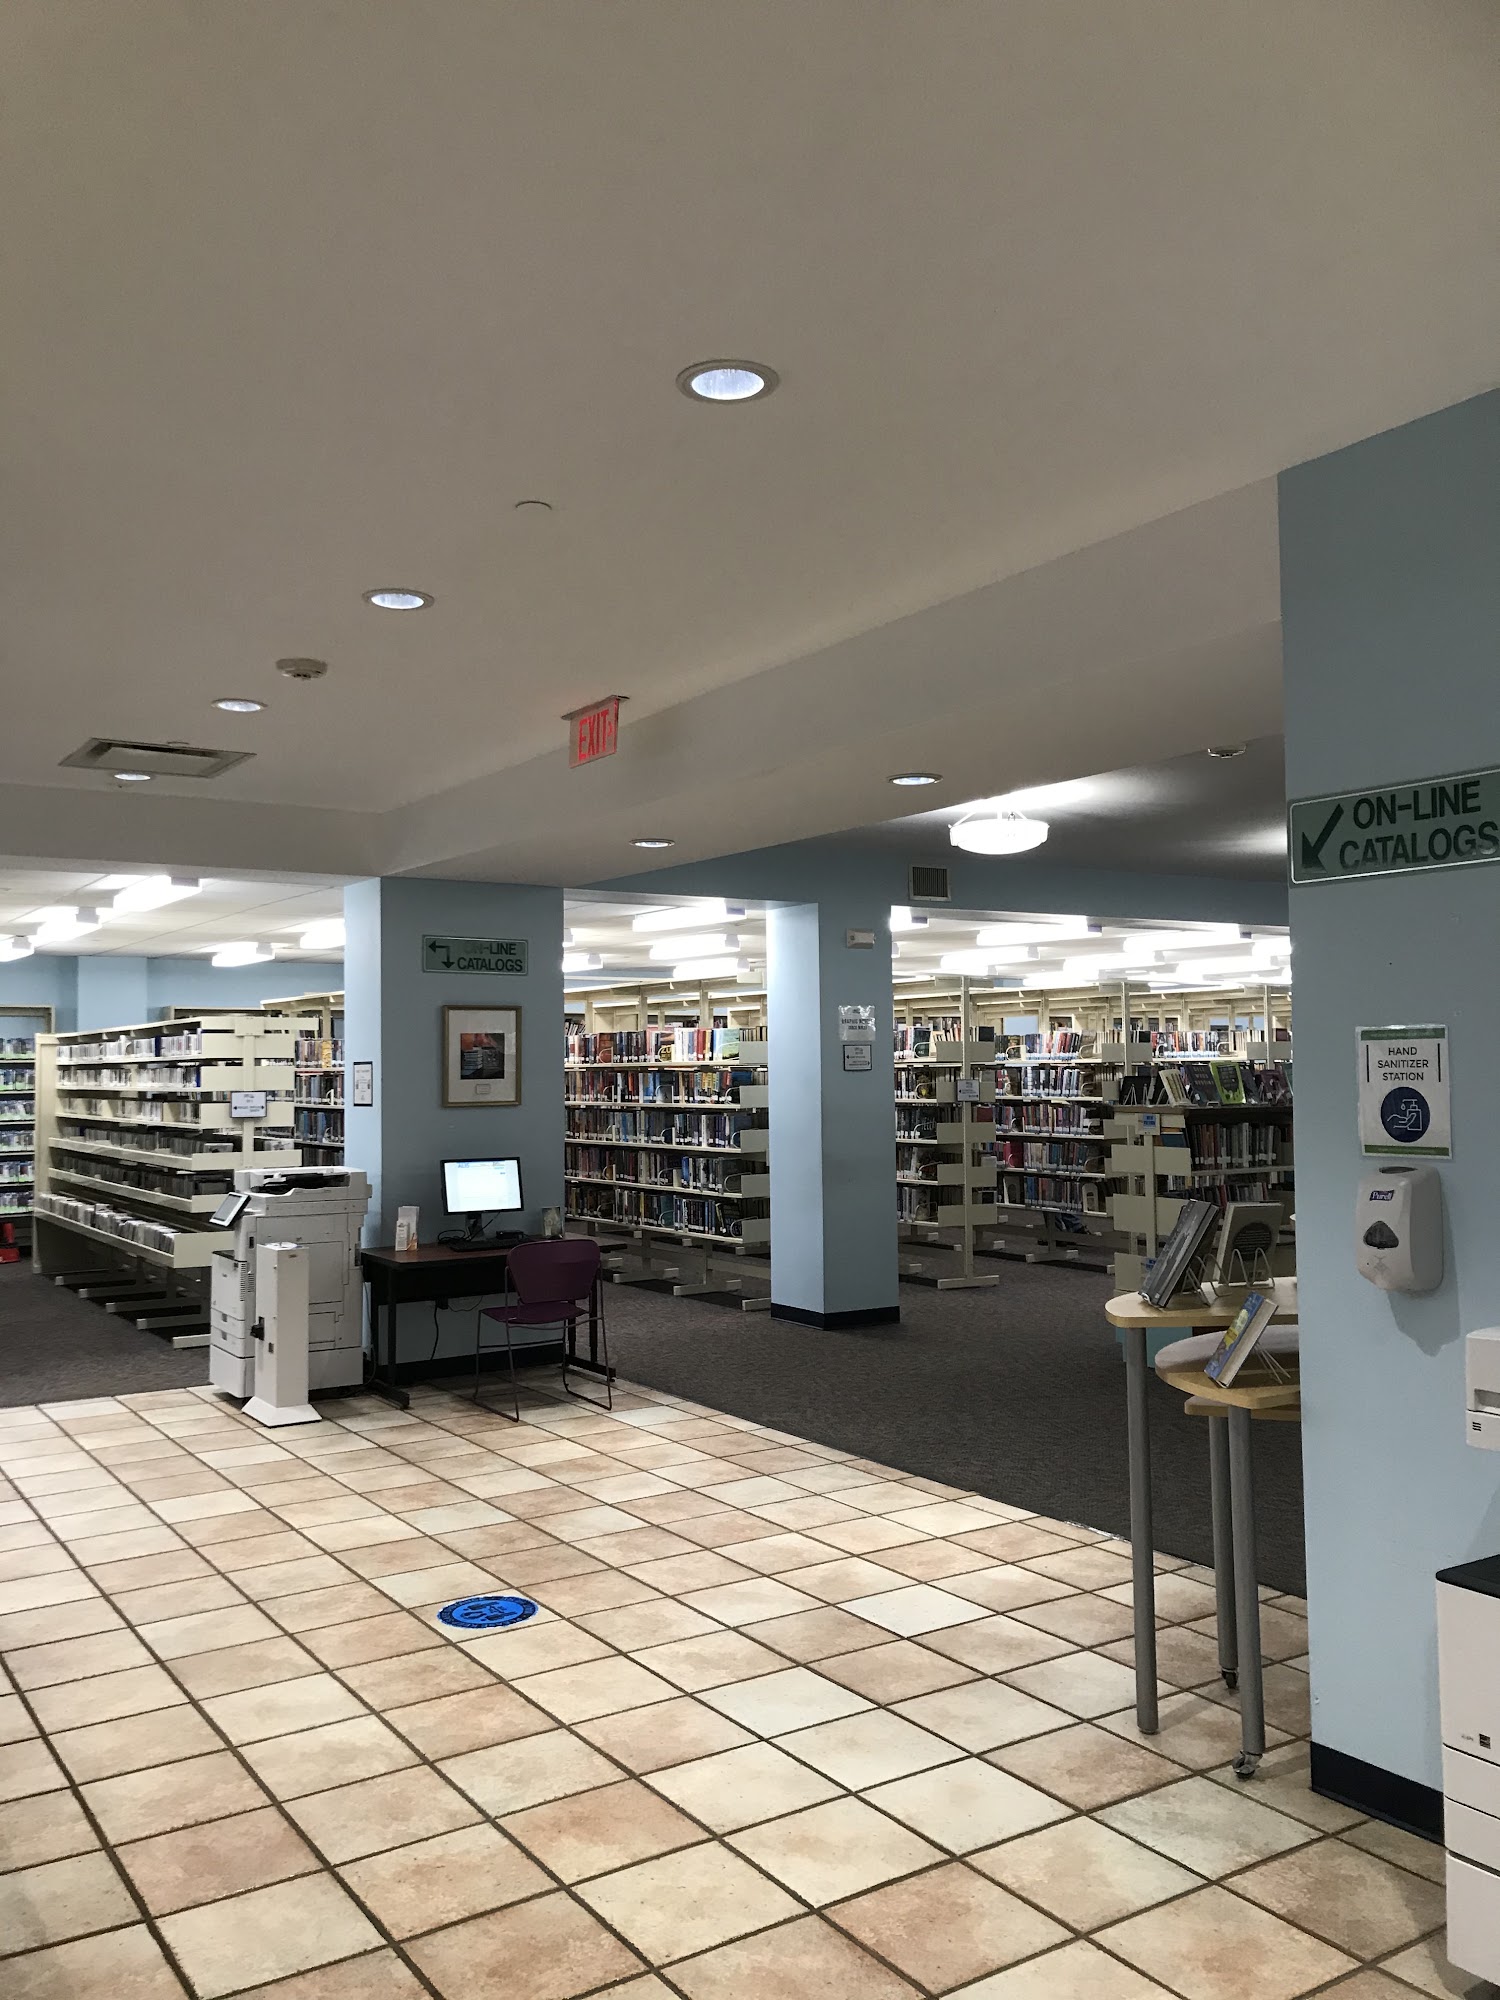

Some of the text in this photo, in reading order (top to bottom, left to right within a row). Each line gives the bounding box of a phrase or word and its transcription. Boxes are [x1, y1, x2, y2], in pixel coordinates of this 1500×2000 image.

[579, 709, 608, 760] EXIT
[1352, 780, 1481, 830] ON-LINE
[1339, 820, 1500, 871] CATALOGS
[464, 942, 517, 956] -LINE
[457, 956, 523, 972] CATALOGS
[1388, 1046, 1418, 1056] HAND
[1377, 1059, 1429, 1069] SANITIZER
[1382, 1072, 1424, 1081] STATION
